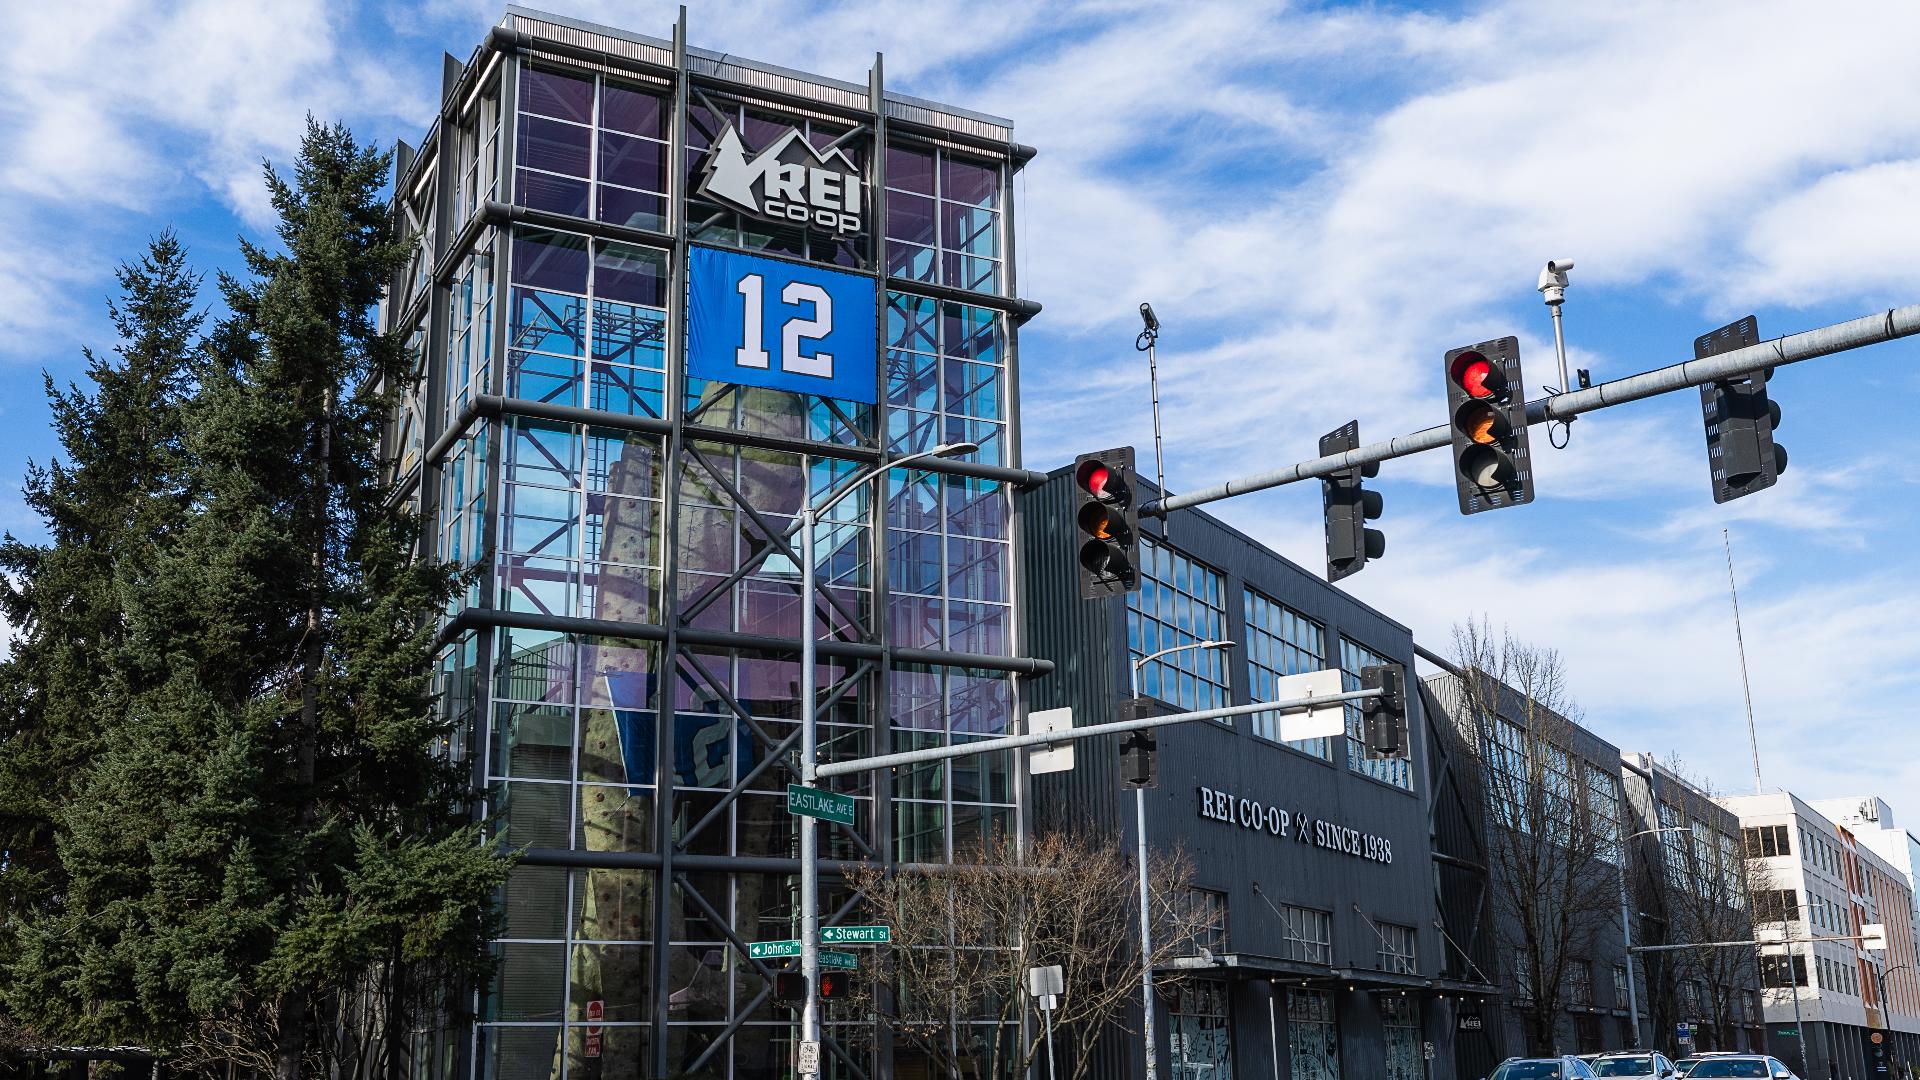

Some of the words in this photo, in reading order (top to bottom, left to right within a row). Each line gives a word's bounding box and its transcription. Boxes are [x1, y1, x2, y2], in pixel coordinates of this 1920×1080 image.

[764, 159, 861, 214] REI
[736, 274, 834, 379] 12
[789, 792, 834, 814] EASTLAKE
[836, 803, 848, 815] AVE
[848, 805, 853, 816] E
[1201, 786, 1236, 824] REI
[1239, 798, 1290, 837] CO-OP
[1315, 819, 1361, 856] SINCE
[1363, 833, 1392, 864] 1938
[836, 928, 874, 939] Stewart
[879, 931, 886, 939] St
[762, 943, 783, 955] John
[818, 952, 842, 965] Eastlake
